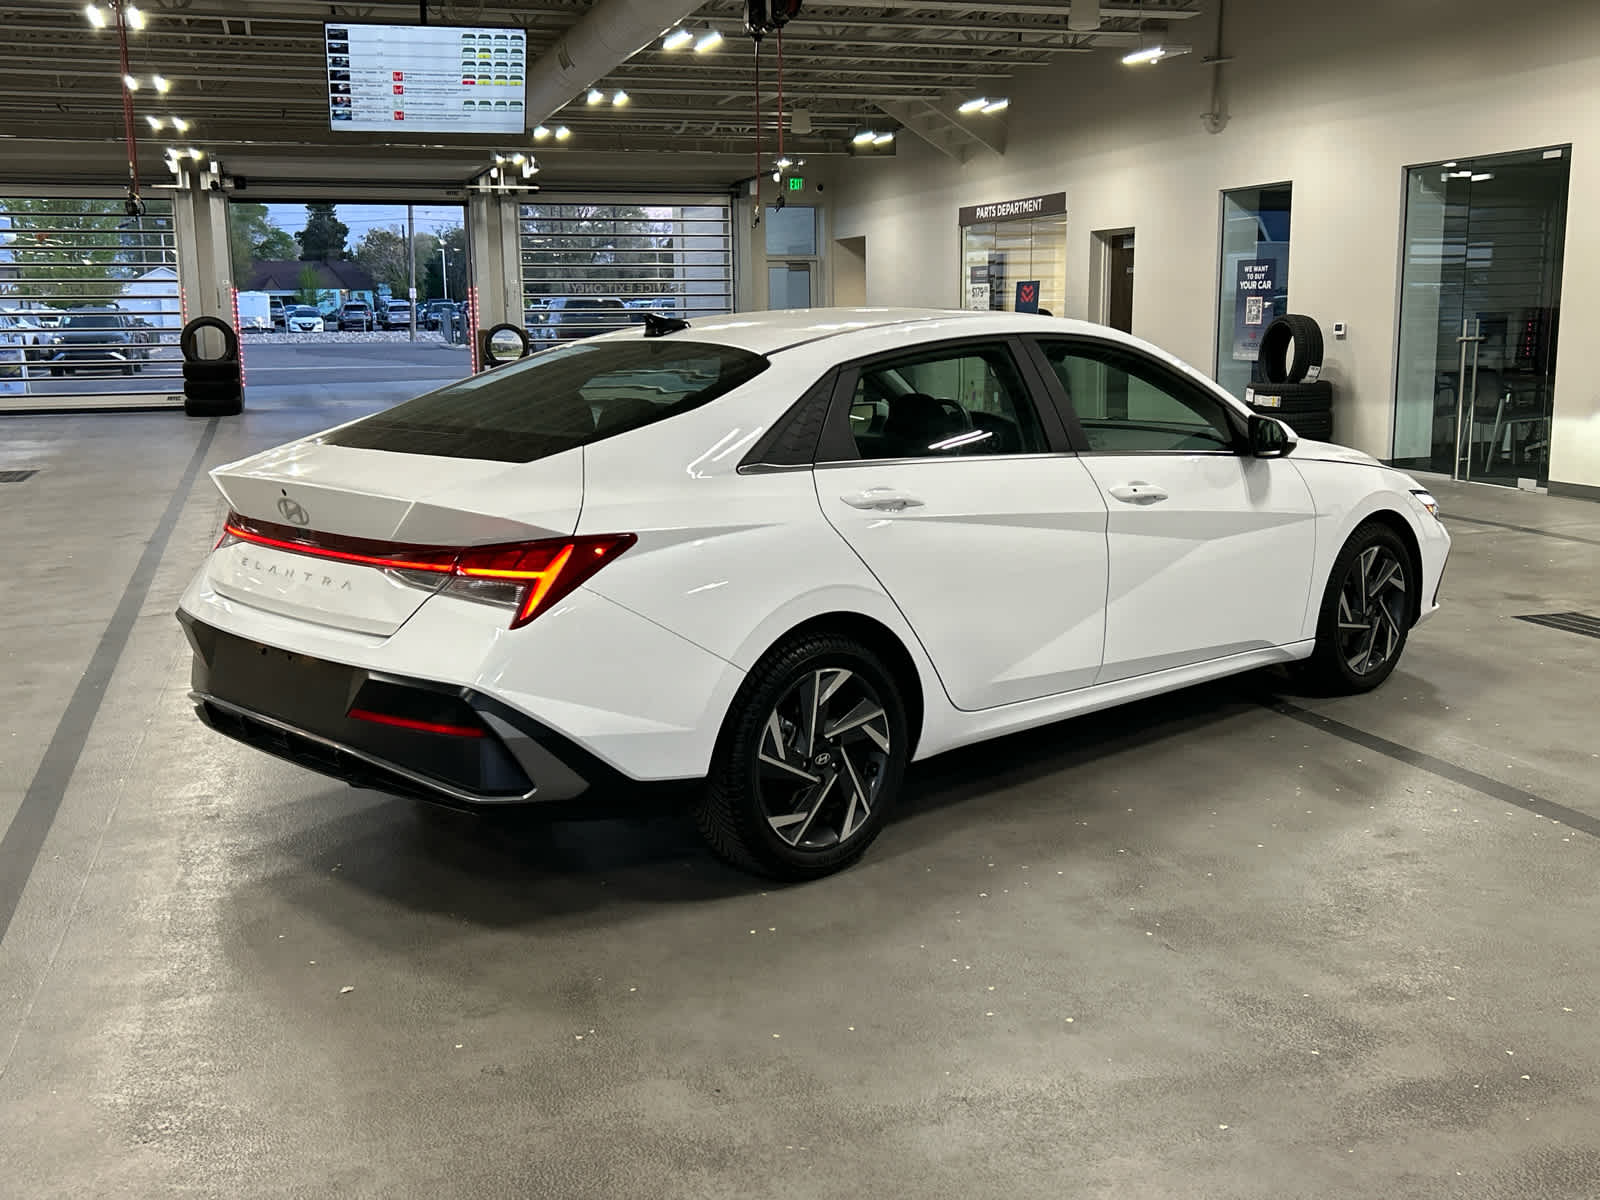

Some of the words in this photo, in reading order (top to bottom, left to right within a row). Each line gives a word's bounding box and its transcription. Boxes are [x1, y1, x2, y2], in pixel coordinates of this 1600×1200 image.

[790, 178, 803, 190] EXIT
[976, 206, 997, 219] PARTS
[997, 199, 1043, 217] DEPARTMENT
[1240, 280, 1258, 290] YOUR
[1258, 280, 1272, 290] CAR
[241, 558, 352, 591] ELANTRA
